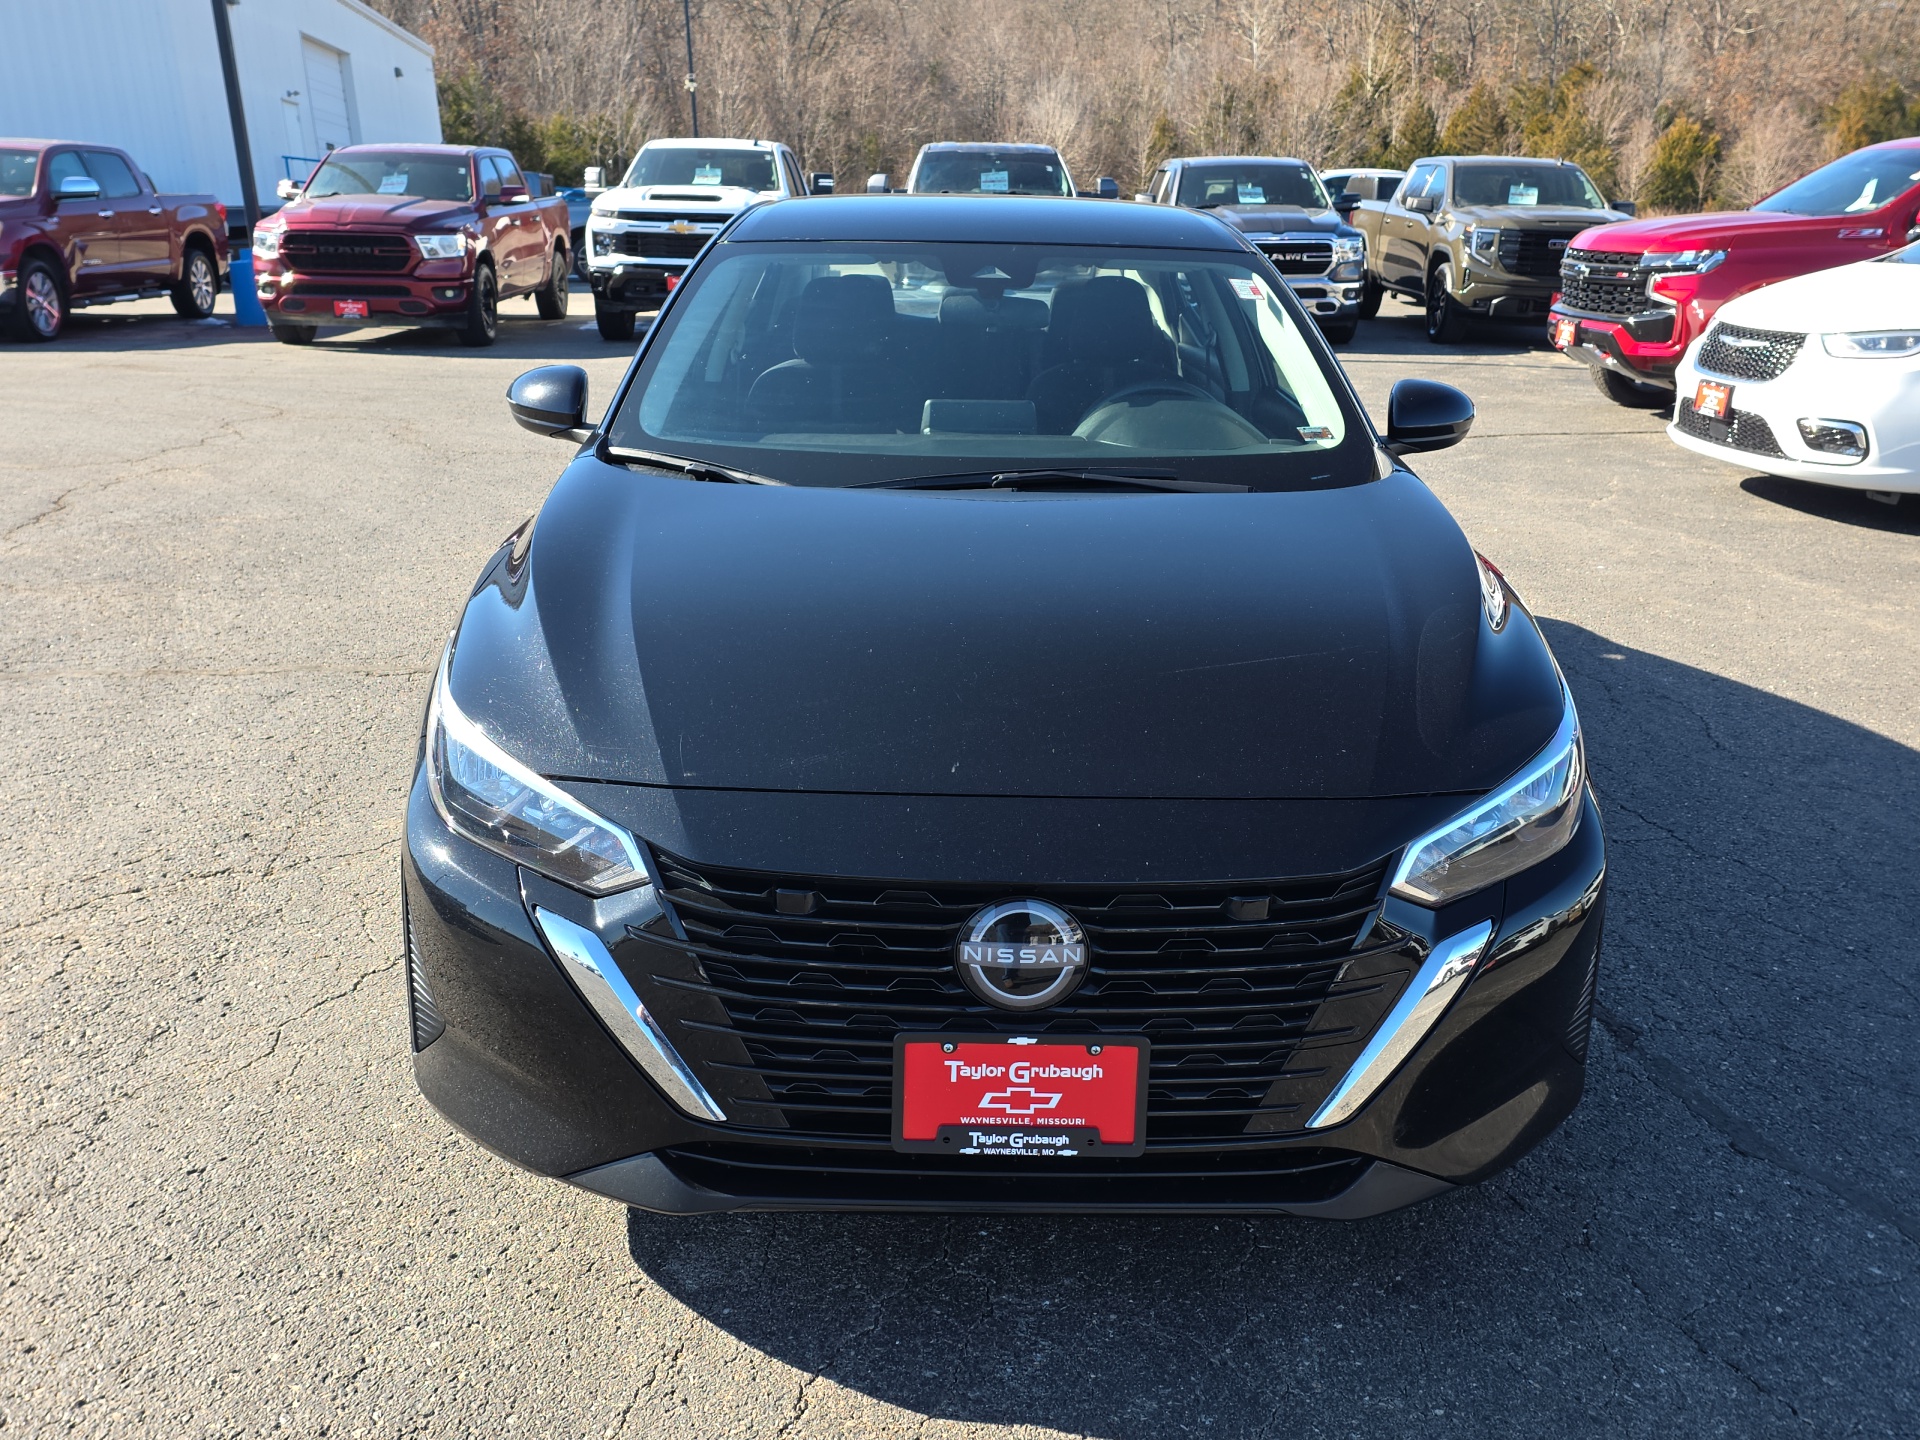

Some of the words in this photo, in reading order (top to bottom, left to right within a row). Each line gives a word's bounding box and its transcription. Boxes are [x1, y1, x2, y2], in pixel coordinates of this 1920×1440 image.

[963, 945, 1080, 964] NISSAN
[944, 1060, 1005, 1083] Taylor
[1008, 1061, 1103, 1084] Grubaugh
[960, 1116, 1034, 1126] WAYNESVILLE,
[1036, 1117, 1086, 1126] MISSOURI
[968, 1131, 1008, 1147] Taylor
[1009, 1132, 1070, 1148] Grubaugh
[983, 1147, 1041, 1157] WAYNESVILLE,
[1041, 1148, 1055, 1156] MO
